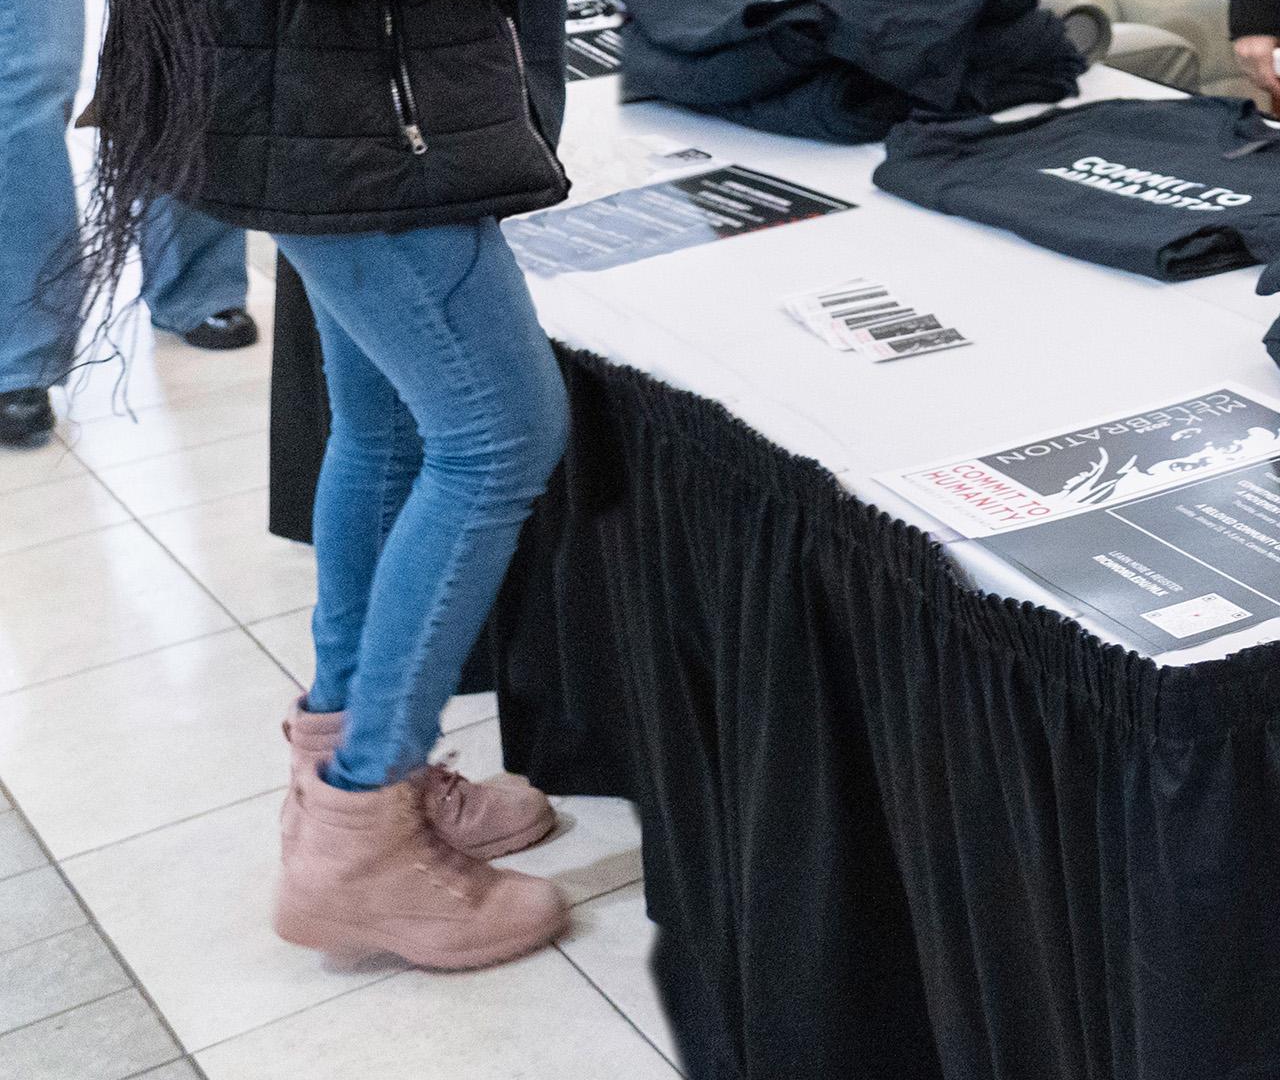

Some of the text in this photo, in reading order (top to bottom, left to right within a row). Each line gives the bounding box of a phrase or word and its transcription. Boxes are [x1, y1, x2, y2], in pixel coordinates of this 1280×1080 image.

[1072, 156, 1252, 207] COMMIT TO
[996, 394, 1231, 465] CELEBRATION
[1182, 400, 1248, 431] MLK
[922, 470, 1027, 522] HUMANITY
[951, 465, 1051, 517] COMMIT TO
